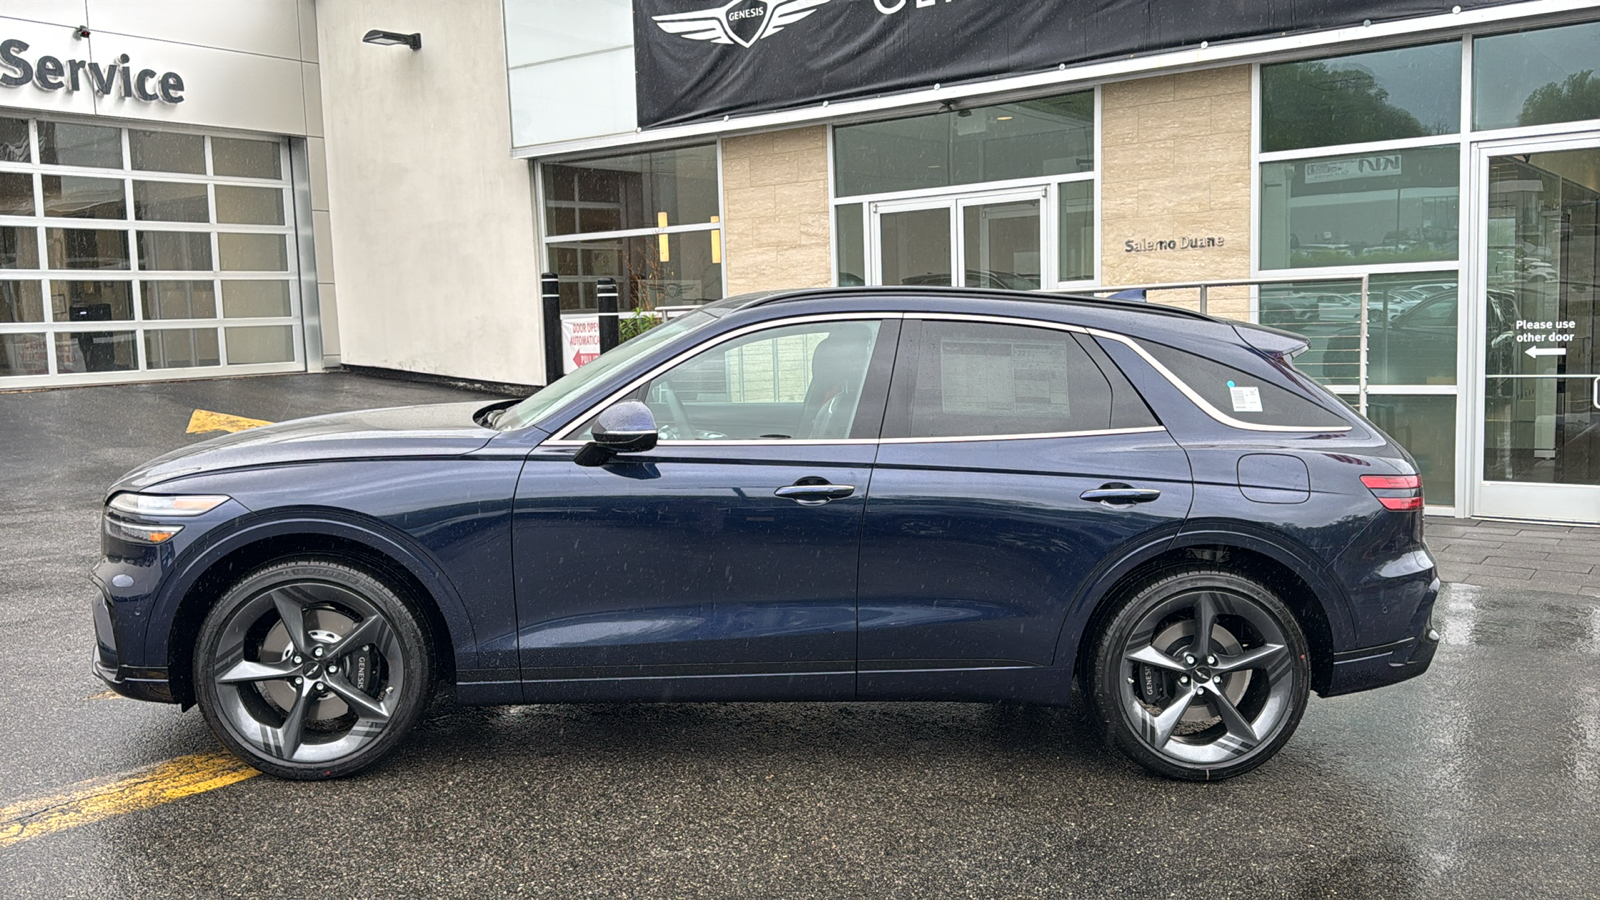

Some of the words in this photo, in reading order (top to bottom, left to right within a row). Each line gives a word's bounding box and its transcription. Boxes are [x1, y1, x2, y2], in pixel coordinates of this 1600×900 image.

[728, 6, 764, 21] GENESIS
[0, 38, 185, 104] Service
[1124, 239, 1177, 253] Salerno
[1180, 236, 1225, 250] Duane
[572, 322, 586, 334] DOOR
[1515, 319, 1553, 330] Please
[1555, 320, 1576, 329] use
[1516, 332, 1546, 342] other
[1548, 331, 1575, 342] door
[357, 656, 366, 689] GENESIS
[1144, 665, 1154, 696] GENESI
